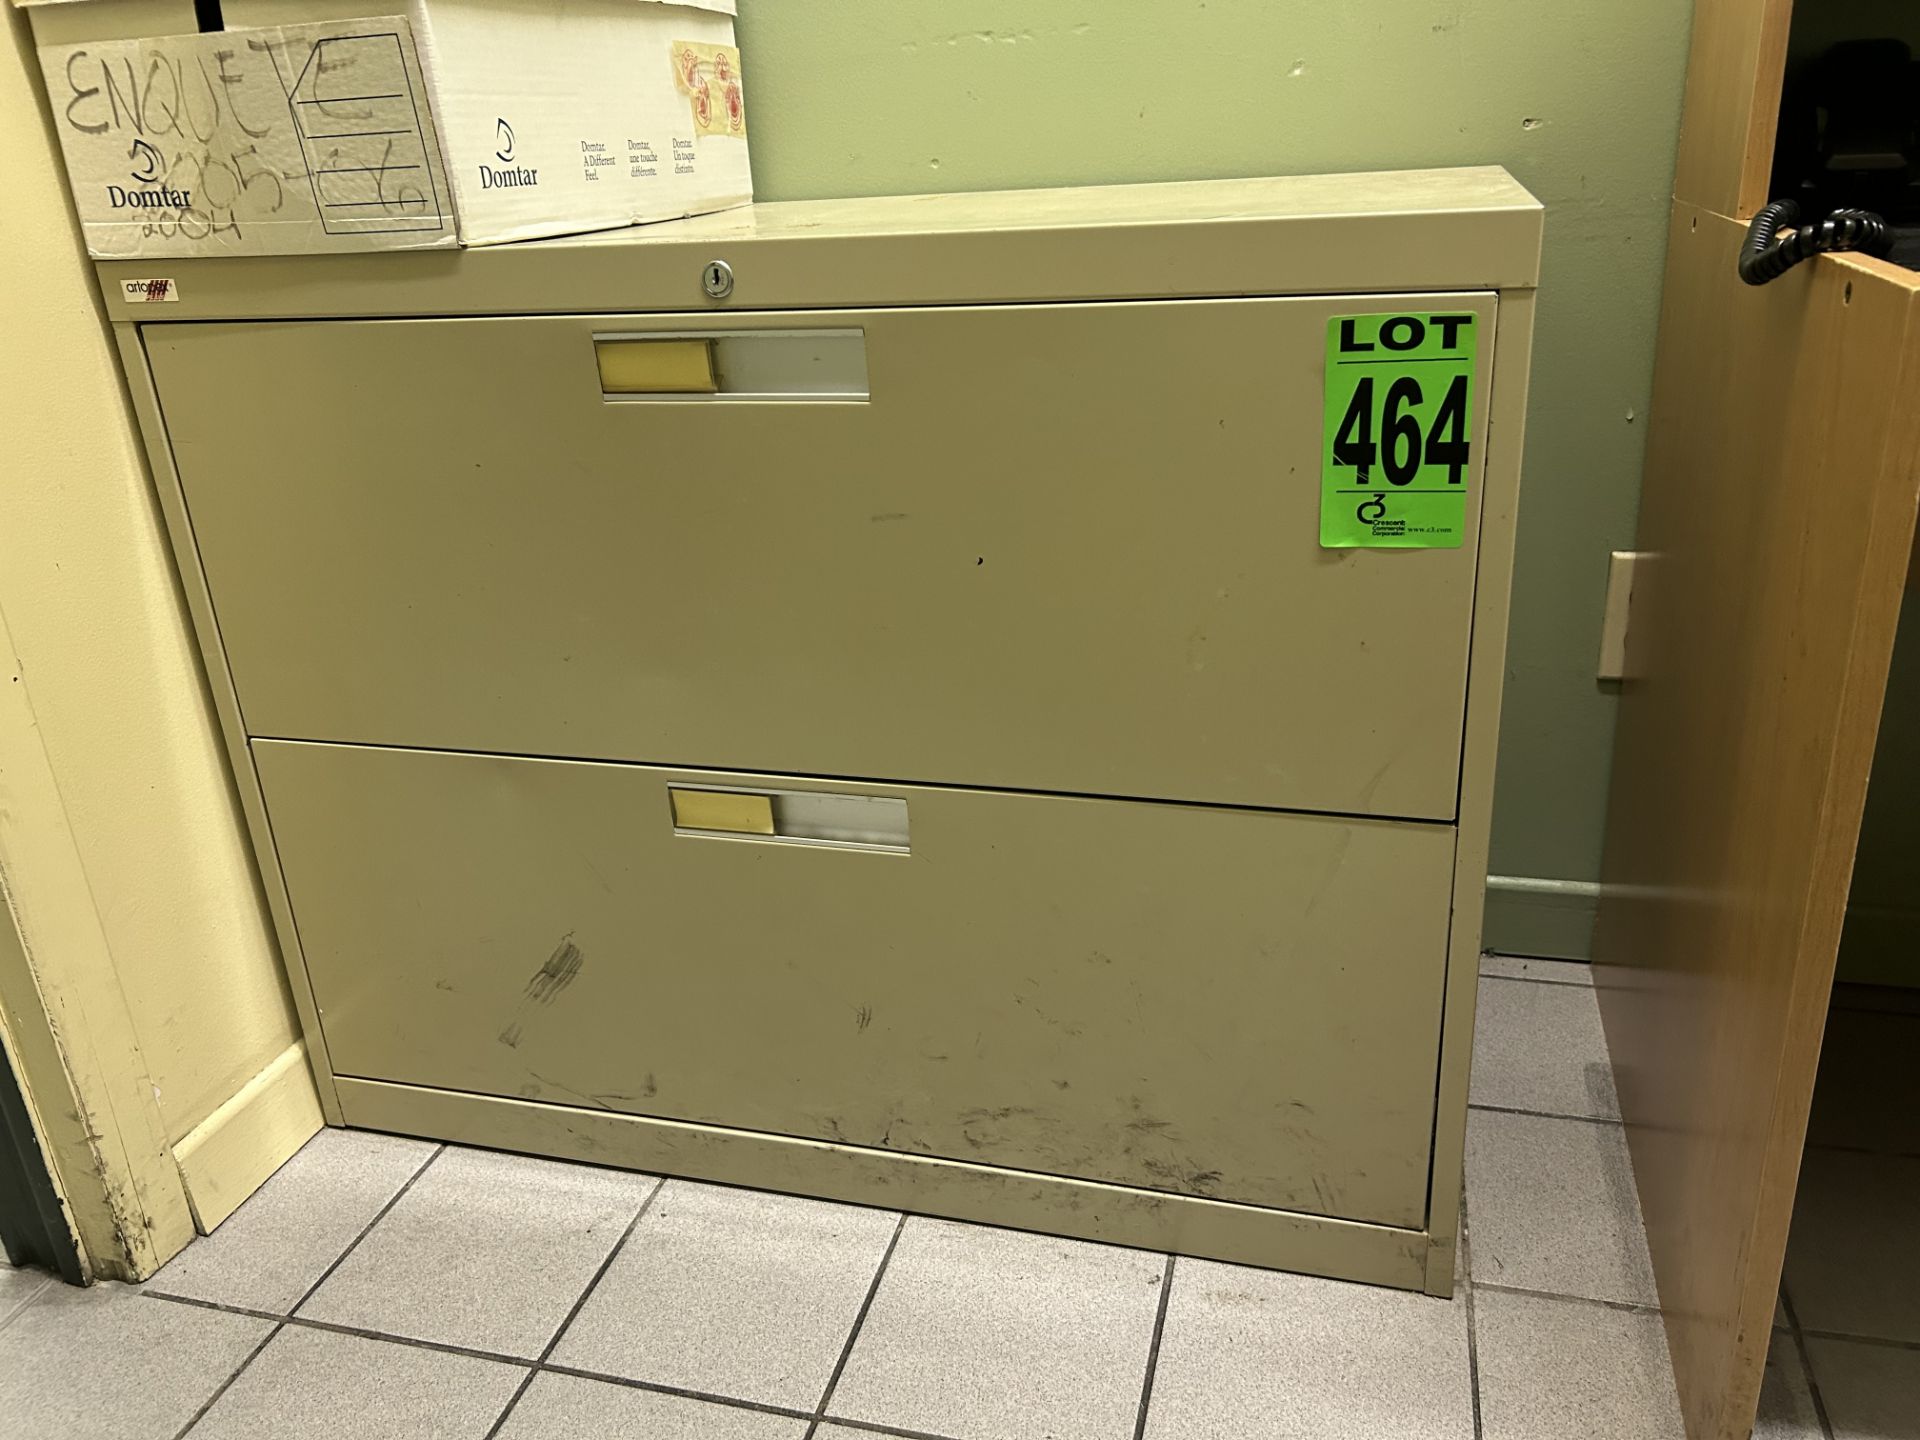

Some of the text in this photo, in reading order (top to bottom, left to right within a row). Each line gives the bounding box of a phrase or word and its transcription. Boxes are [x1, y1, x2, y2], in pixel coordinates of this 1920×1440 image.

[584, 154, 616, 167] A Different
[629, 152, 658, 163] une touche
[674, 151, 696, 163] Un toque
[479, 165, 538, 189] Domtar
[106, 185, 191, 209] Domtar
[1340, 316, 1472, 352] LOT
[1333, 375, 1470, 486] 464
